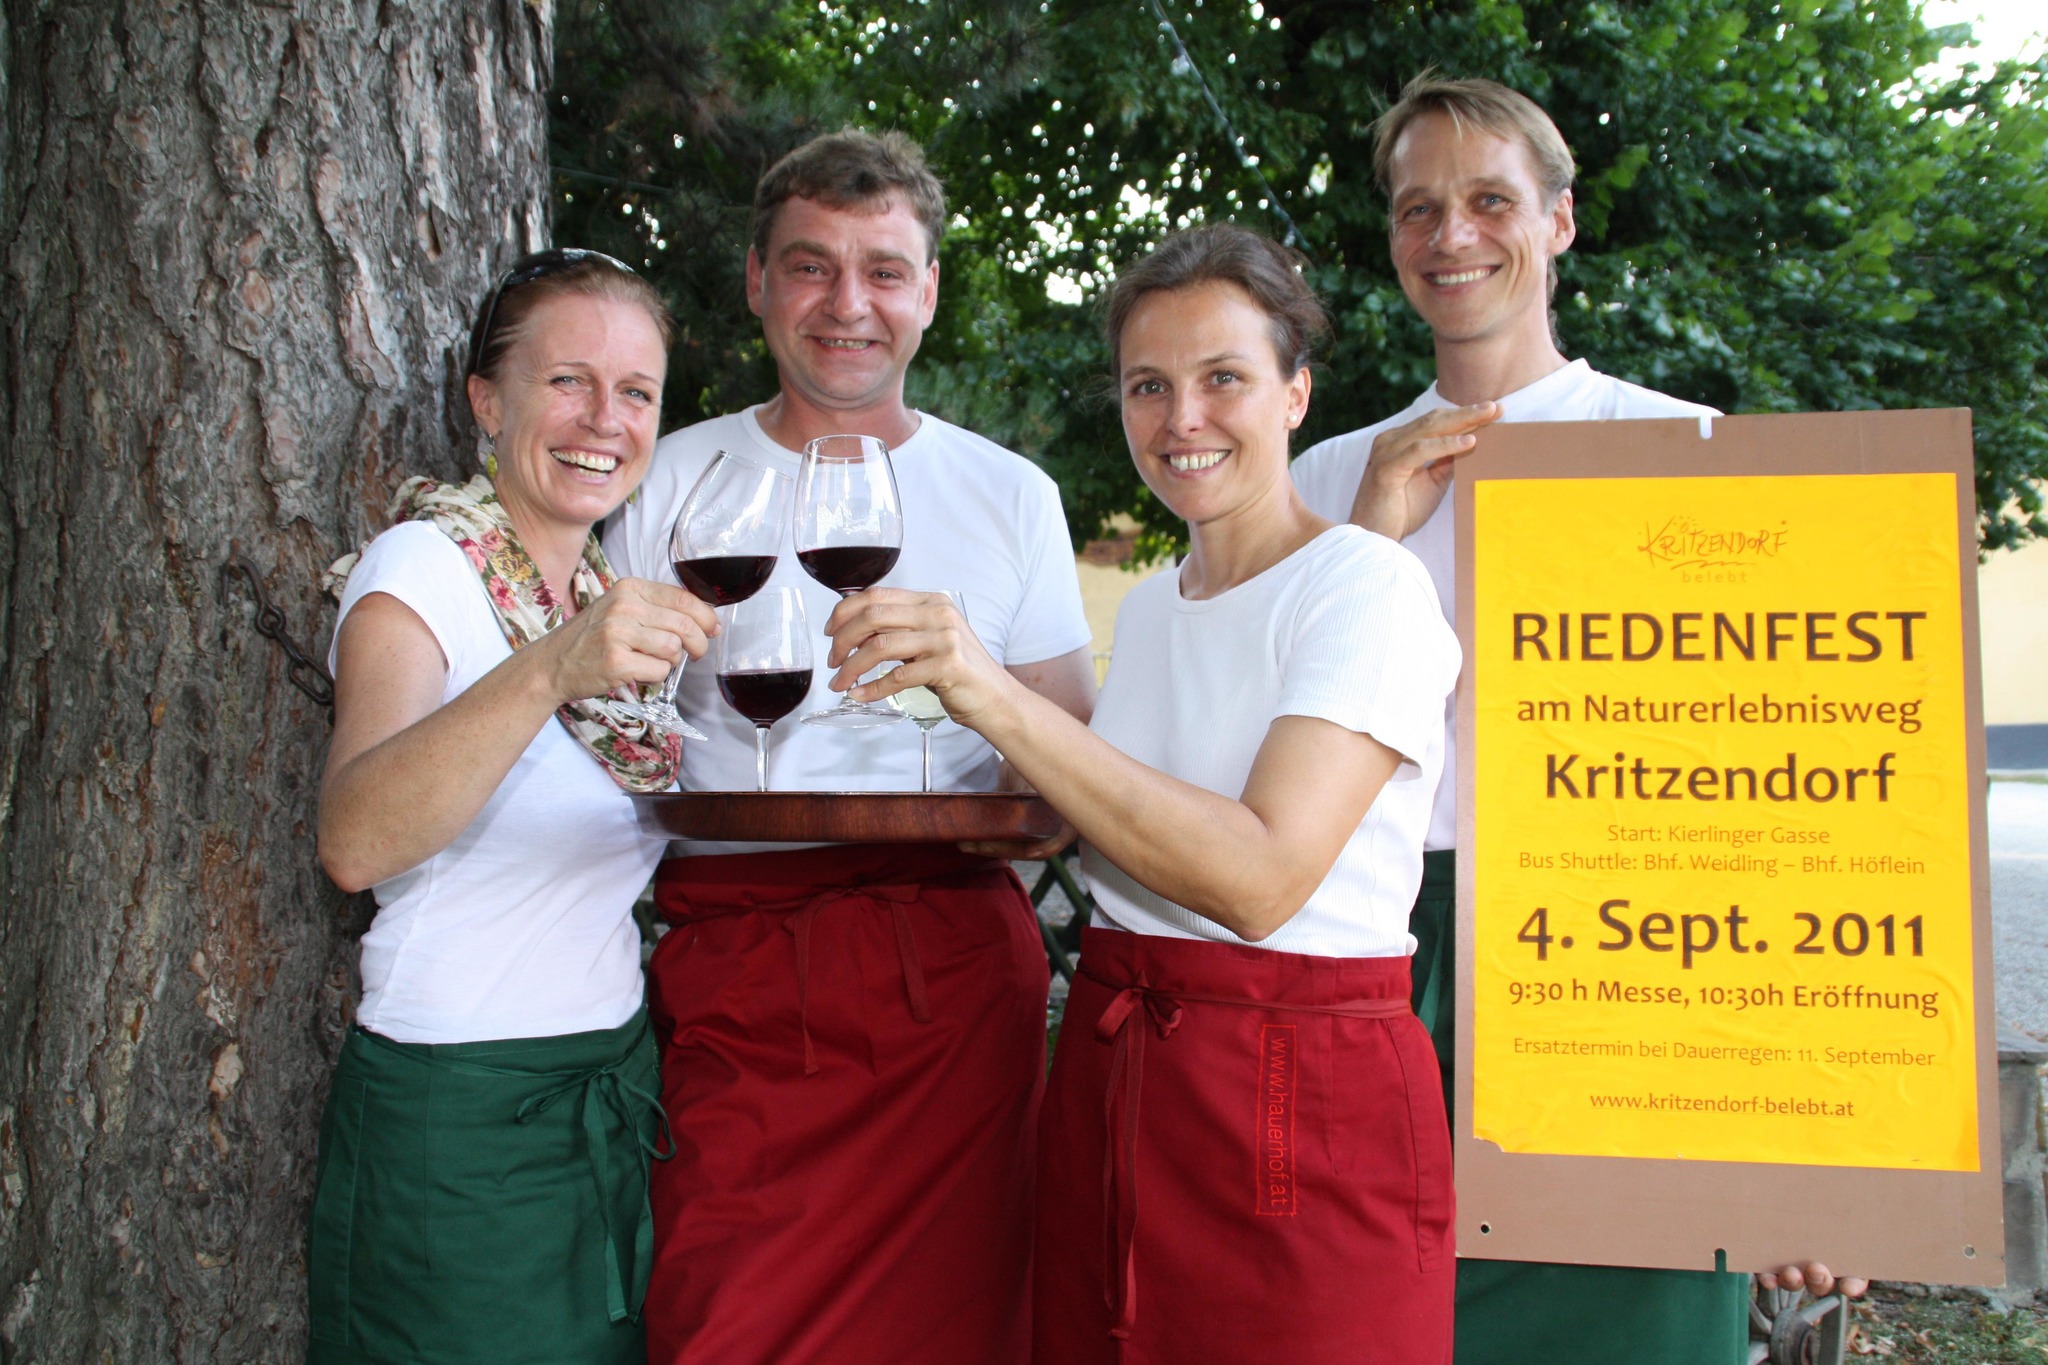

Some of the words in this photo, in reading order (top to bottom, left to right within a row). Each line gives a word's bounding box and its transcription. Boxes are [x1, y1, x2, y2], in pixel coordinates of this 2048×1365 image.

[1682, 570, 1748, 583] belebt
[1512, 610, 1927, 663] RIEDENFEST
[1517, 700, 1571, 722] am
[1584, 692, 1923, 735] Naturerlebnisweg
[1546, 751, 1896, 803] Kritzendorf
[1607, 824, 1662, 842] Start:
[1668, 824, 1766, 849] Kierlinger
[1770, 826, 1831, 845] Gasse
[1519, 851, 1554, 869] Bus
[1559, 851, 1638, 871] Shuttle:
[1644, 852, 1684, 871] Bhf.
[1689, 853, 1779, 879] Weidling
[1802, 854, 1843, 873] Bhf.
[1849, 855, 1925, 875] Höflein
[1516, 907, 1575, 962] 4.
[1598, 898, 1769, 970] Sept.
[1793, 912, 1924, 957] 2011
[1508, 981, 1564, 1006] 9:30
[1571, 977, 1588, 1001] h
[1597, 980, 1690, 1009] Messe,
[1699, 982, 1784, 1012] 10:30h
[1793, 984, 1940, 1019] Eröffnung
[1513, 1037, 1633, 1057] Ersatztermin
[1638, 1039, 1667, 1058] bei
[1673, 1041, 1792, 1067] Dauerregen:
[1797, 1048, 1819, 1063] 11.
[1824, 1046, 1937, 1069] September
[1267, 1037, 1289, 1207] www.hauerhof.at
[1589, 1092, 1855, 1117] www.kritzendorf-belebt.at
